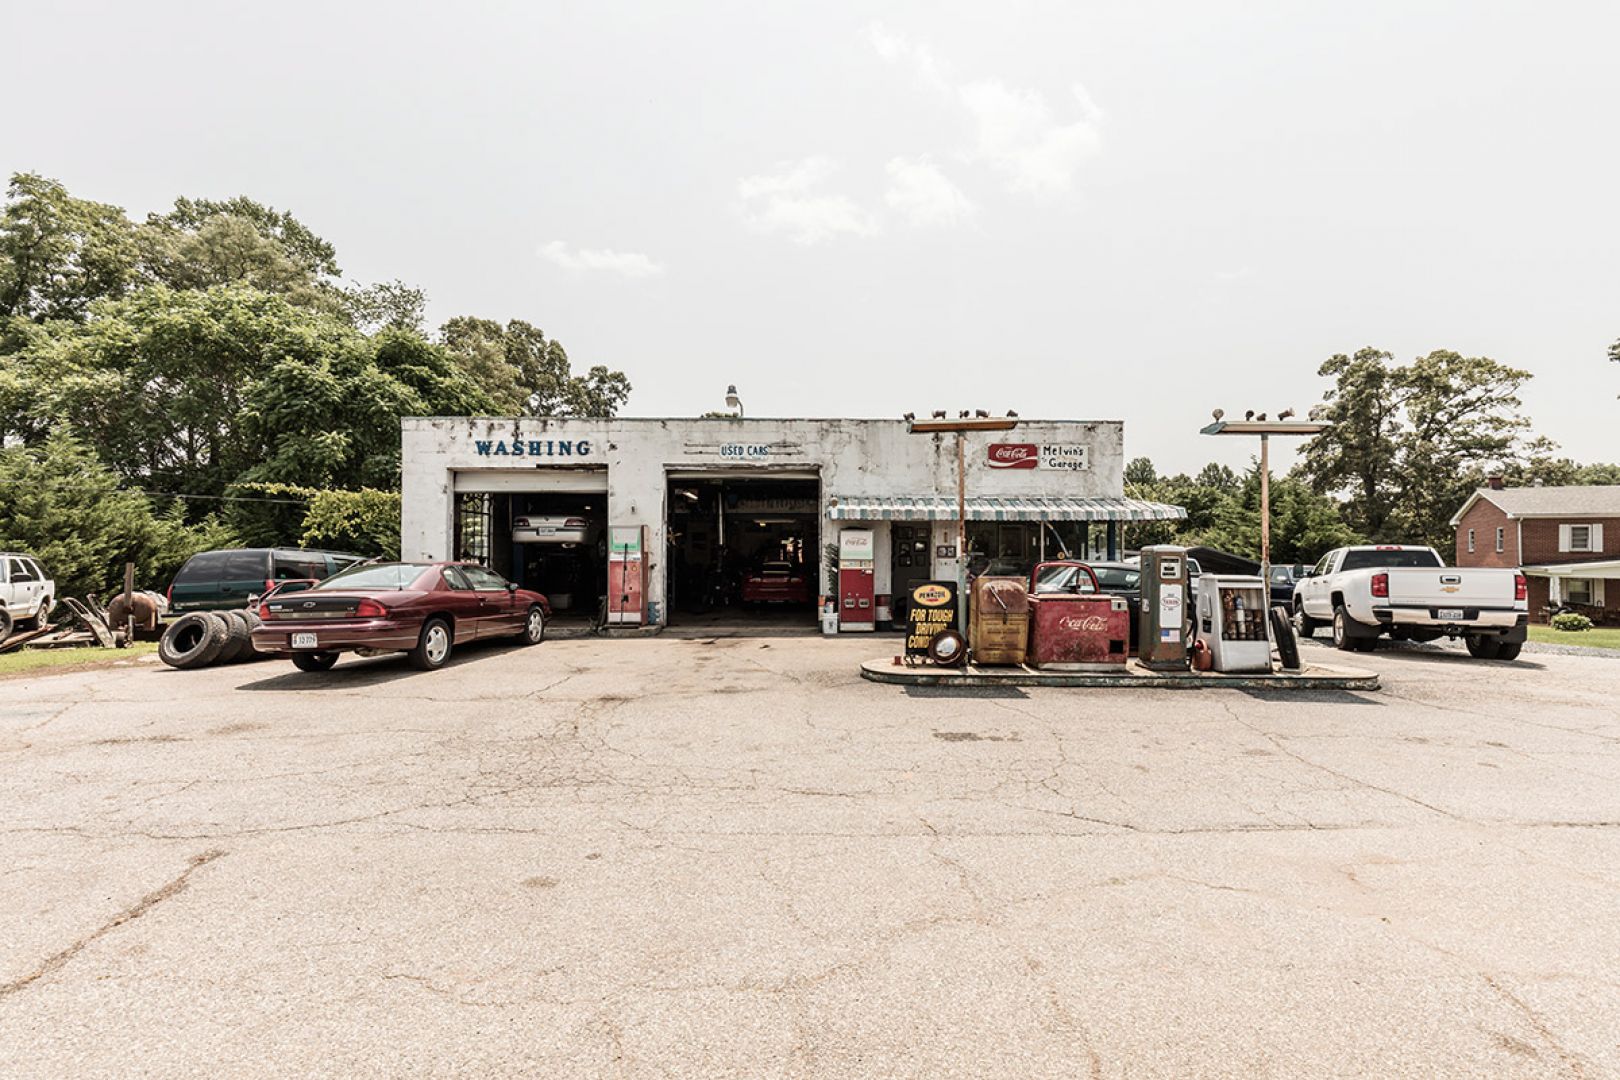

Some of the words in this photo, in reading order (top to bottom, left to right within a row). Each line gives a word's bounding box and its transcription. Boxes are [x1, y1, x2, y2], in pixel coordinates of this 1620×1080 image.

[475, 440, 590, 455] WASHING
[721, 446, 744, 456] USED
[747, 445, 768, 456] CARS
[1043, 446, 1083, 456] Melvin's
[1049, 458, 1082, 471] Garage
[909, 608, 927, 622] FOR
[928, 608, 954, 622] TOUGH
